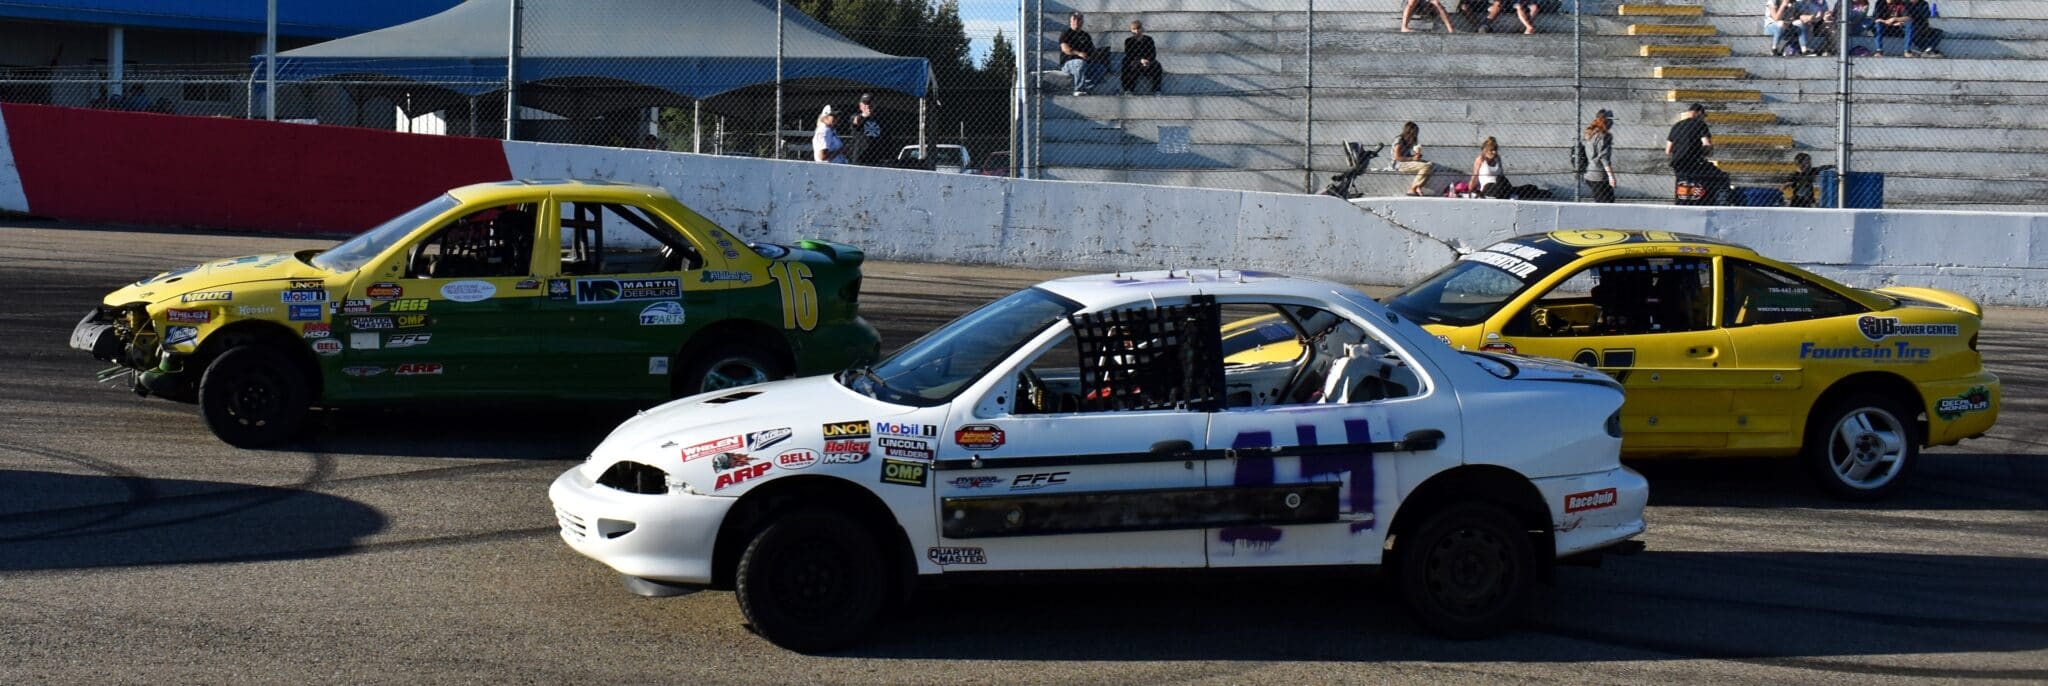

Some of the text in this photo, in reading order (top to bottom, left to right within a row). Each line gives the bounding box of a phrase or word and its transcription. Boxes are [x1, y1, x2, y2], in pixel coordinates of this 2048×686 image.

[290, 281, 324, 289] UNOH
[623, 281, 677, 289] MARTIN
[183, 291, 230, 301] MOOG
[283, 291, 313, 301] Mobil
[624, 289, 677, 298] DEERLINE
[768, 260, 818, 331] 16
[240, 304, 275, 315] Hoosier
[389, 299, 429, 312] JEGS
[167, 310, 209, 319] WHELEN
[398, 315, 425, 325] OMP
[304, 330, 330, 338] MSD
[1895, 325, 1958, 335] POWER CENTRE
[316, 342, 340, 350] BELL
[1800, 342, 1931, 359] Fountain Tire
[397, 363, 442, 374] ARP
[824, 423, 870, 436] UNOH
[877, 422, 919, 435] Mobil
[684, 436, 738, 456] WHELEN
[824, 441, 869, 455] Holley
[880, 438, 925, 450] LINCOLN
[780, 452, 814, 465] BELL
[823, 453, 864, 464] MSD
[890, 449, 929, 459] WELDERS
[714, 461, 773, 491] ARP
[885, 463, 923, 480] OMP
[1011, 471, 1071, 486] PFC
[1569, 491, 1613, 509] RaceQuip
[929, 549, 981, 559] QUARTER
[938, 554, 984, 563] MASTER
